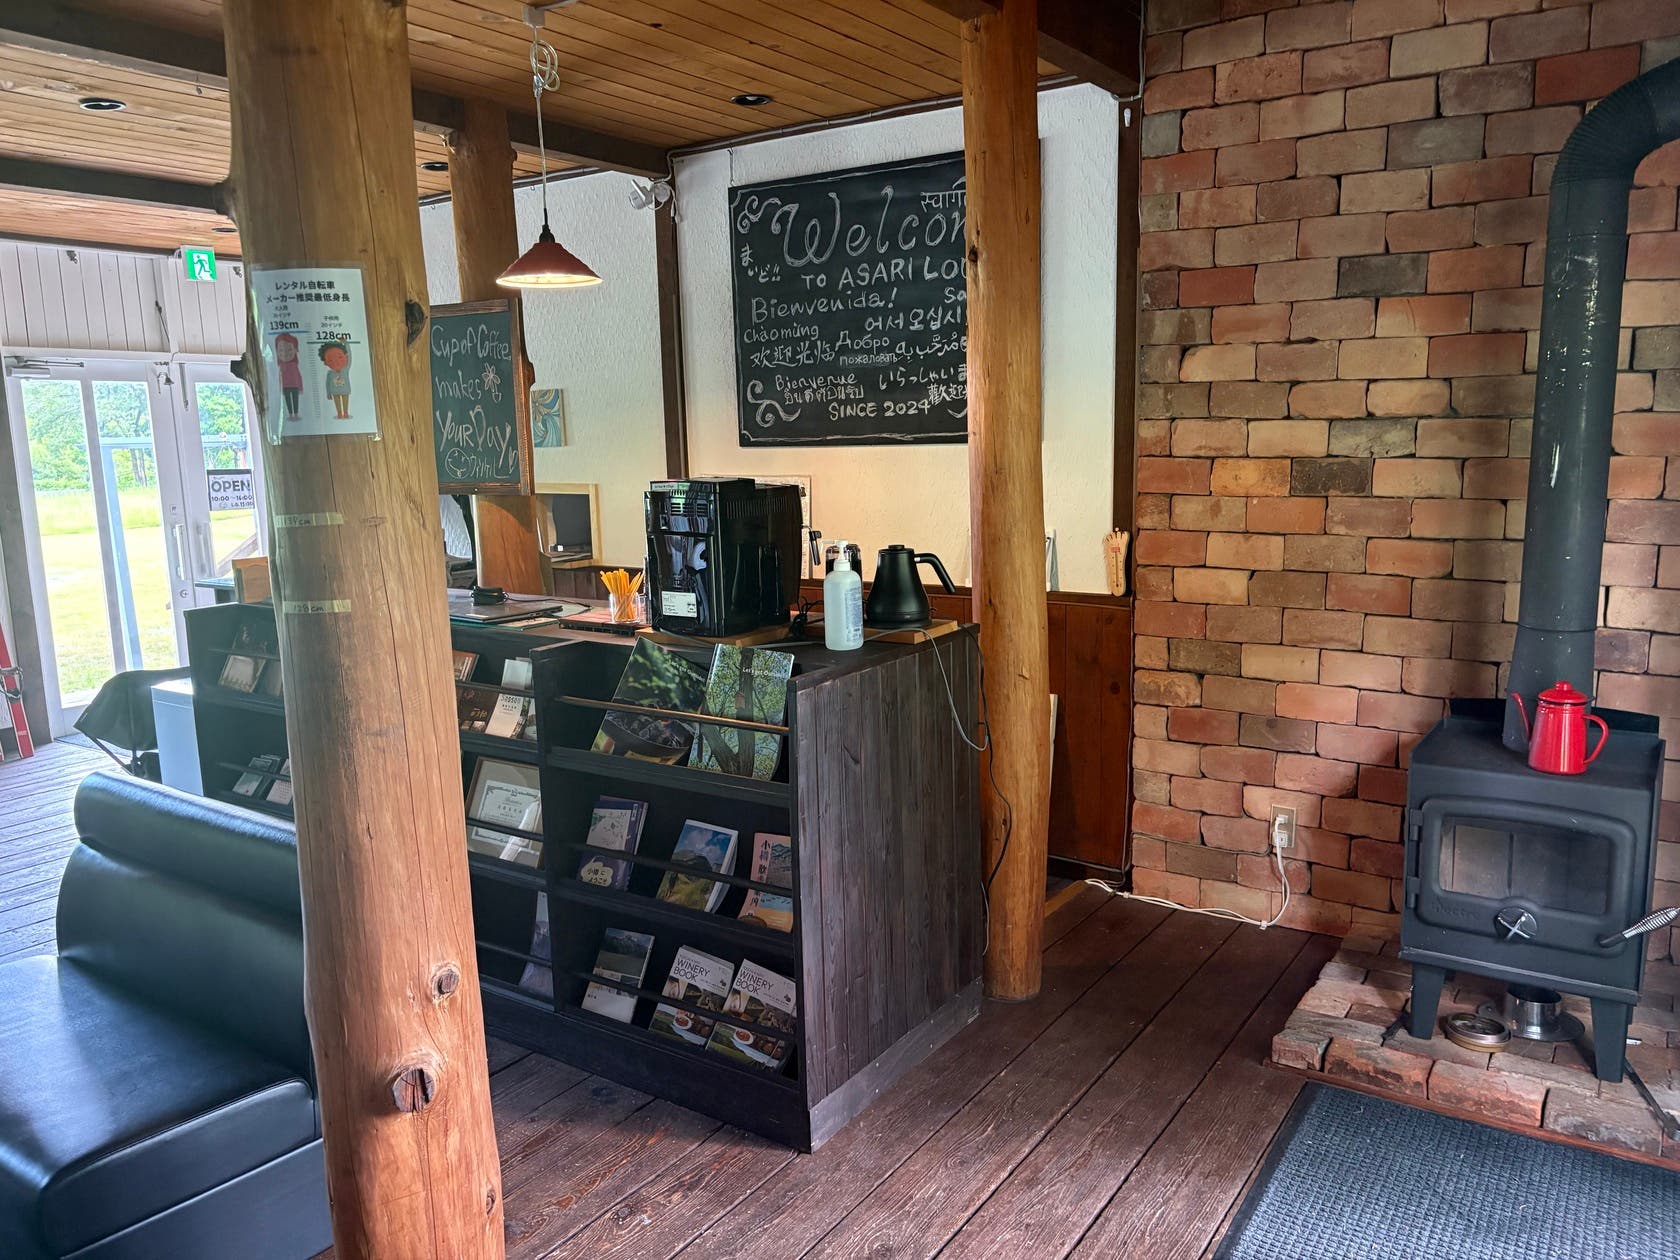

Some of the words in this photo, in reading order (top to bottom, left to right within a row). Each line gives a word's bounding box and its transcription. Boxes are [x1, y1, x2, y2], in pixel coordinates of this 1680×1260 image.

[771, 185, 967, 267] Welco
[801, 274, 827, 290] TO
[838, 257, 913, 292] ASARI
[275, 280, 336, 291] レンタル自転車
[751, 287, 896, 324] Bienvenida!
[270, 320, 299, 331] 139cm
[316, 331, 352, 341] 128cm
[435, 369, 482, 400] makes
[775, 373, 858, 392] Bienvenue
[829, 402, 878, 421] SINCE
[883, 399, 931, 418] 2024
[211, 480, 251, 492] OPEN
[673, 966, 699, 982] BOOK
[677, 958, 711, 977] WINERY
[735, 978, 761, 995] BOOK
[740, 969, 774, 991] WINERY
